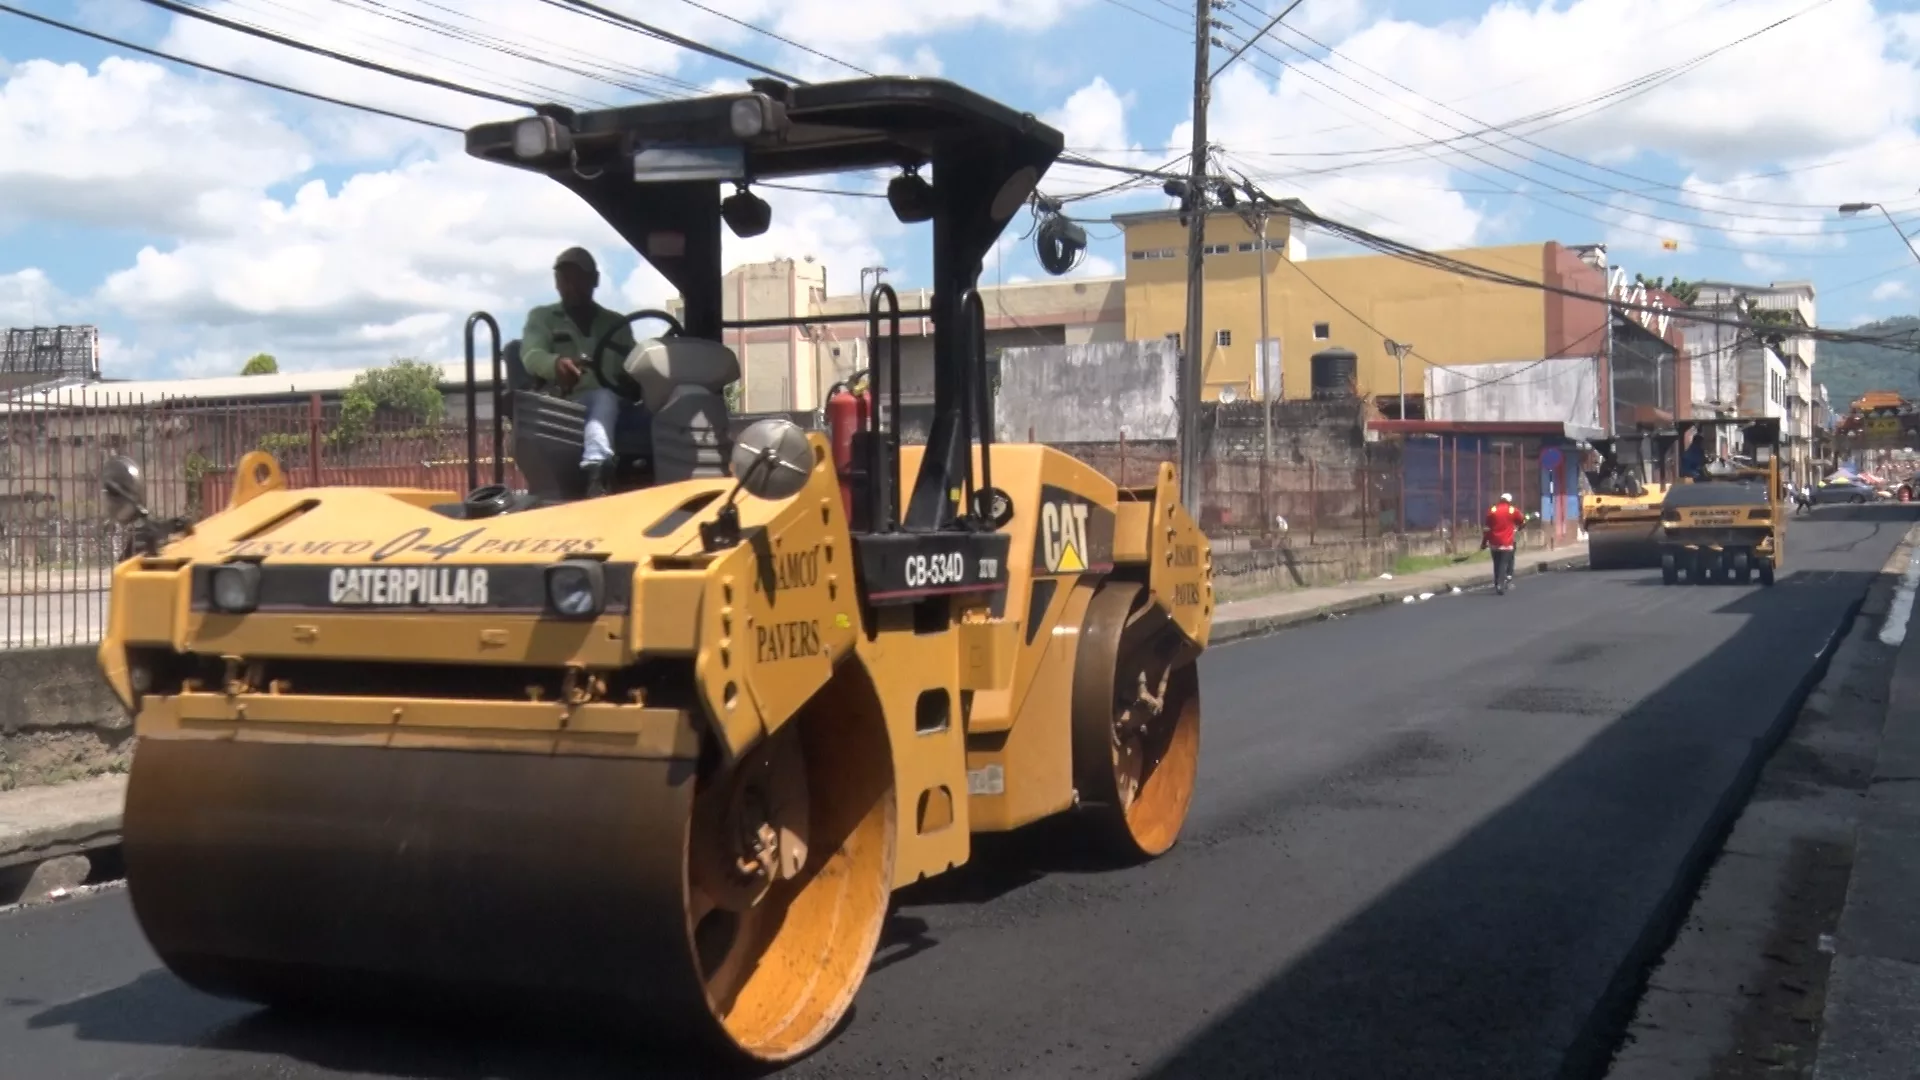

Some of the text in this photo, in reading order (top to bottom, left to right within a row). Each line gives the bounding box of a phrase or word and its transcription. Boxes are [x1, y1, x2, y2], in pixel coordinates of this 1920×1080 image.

[1042, 501, 1089, 573] CAT
[329, 566, 489, 605] CATERPILLAR
[905, 551, 964, 587] CB-534D
[756, 621, 819, 664] PAVERS
